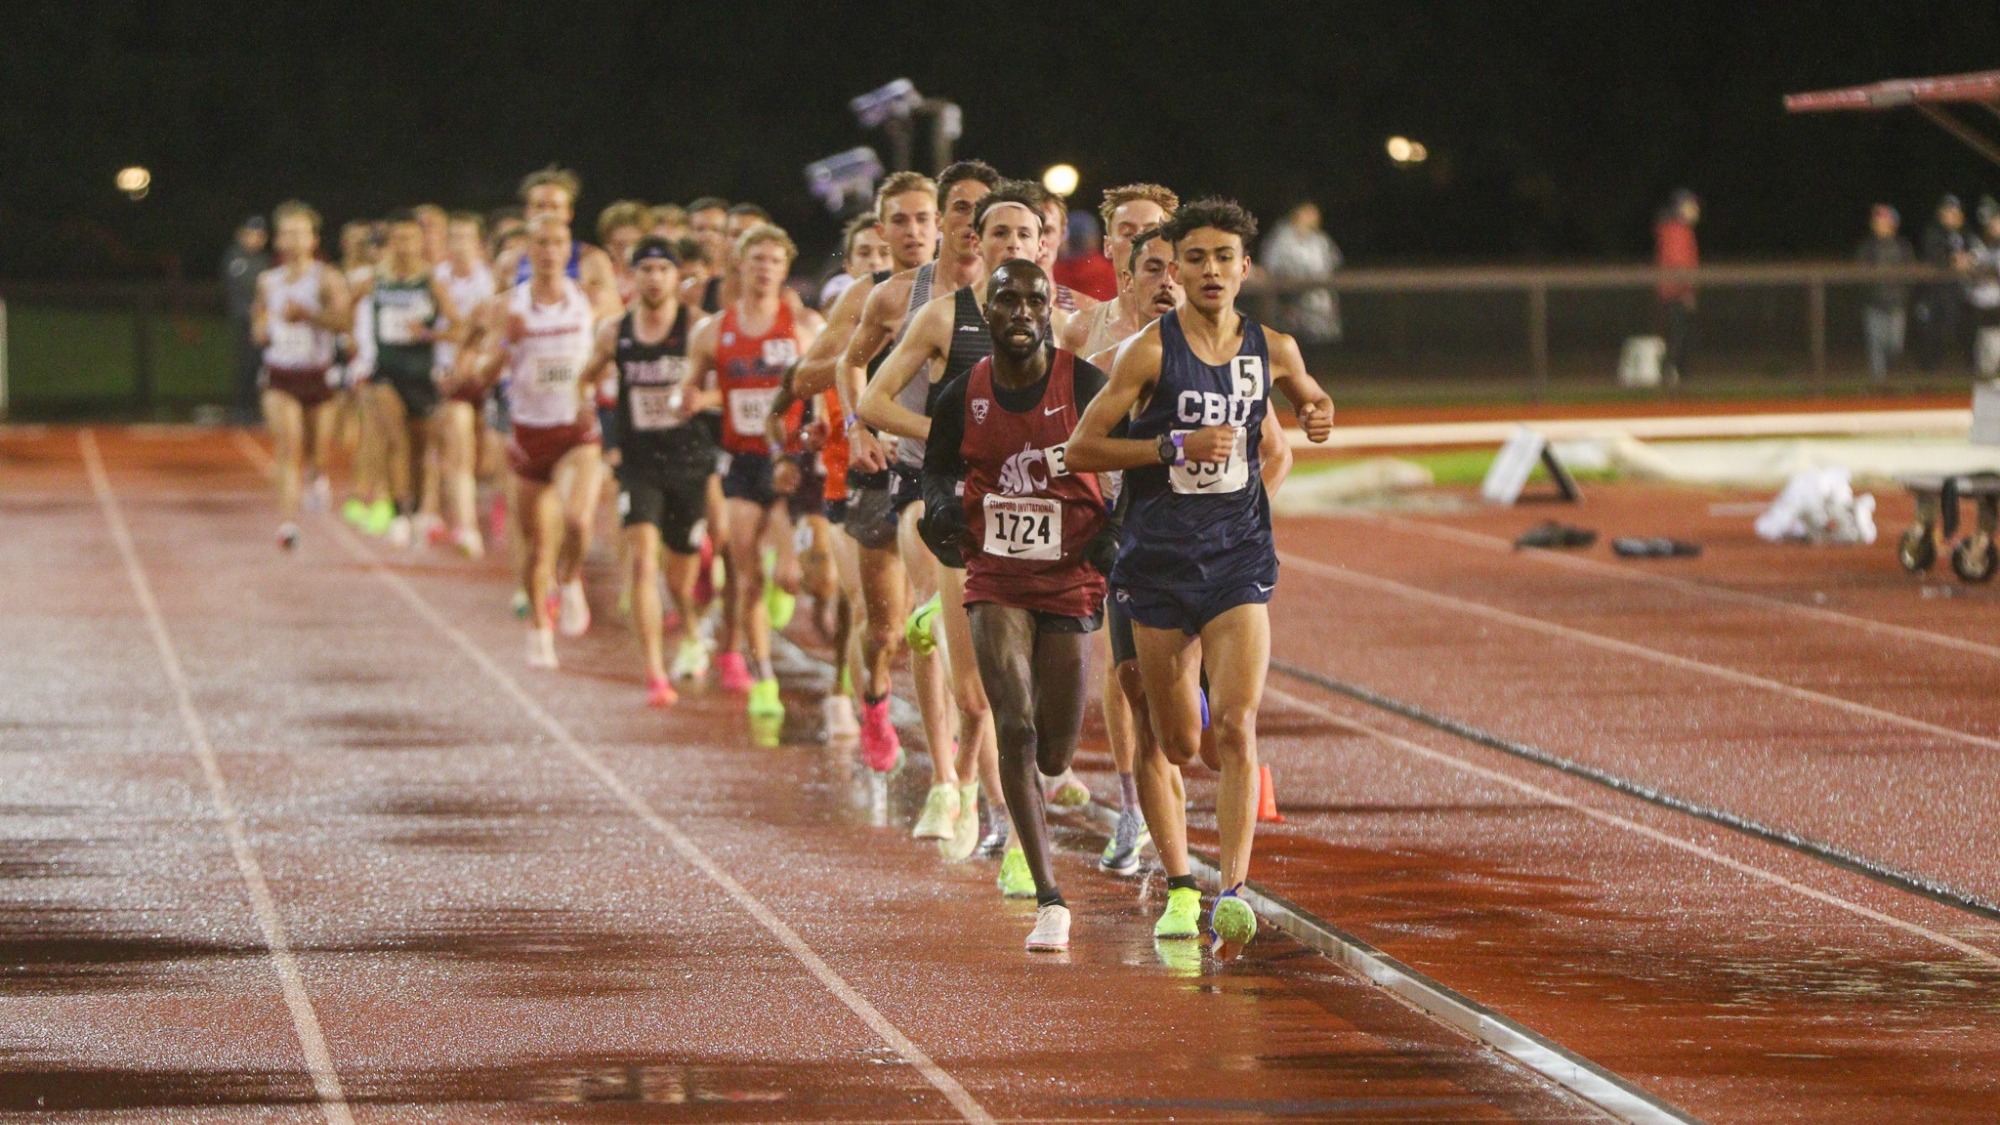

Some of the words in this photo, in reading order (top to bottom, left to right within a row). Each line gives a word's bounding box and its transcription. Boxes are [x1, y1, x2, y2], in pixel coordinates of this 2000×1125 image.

[1238, 358, 1258, 398] 5
[1177, 389, 1253, 428] CBU
[989, 500, 1017, 512] STANFORD
[1017, 502, 1055, 514] INVITATIONAL
[994, 511, 1051, 545] 1724
